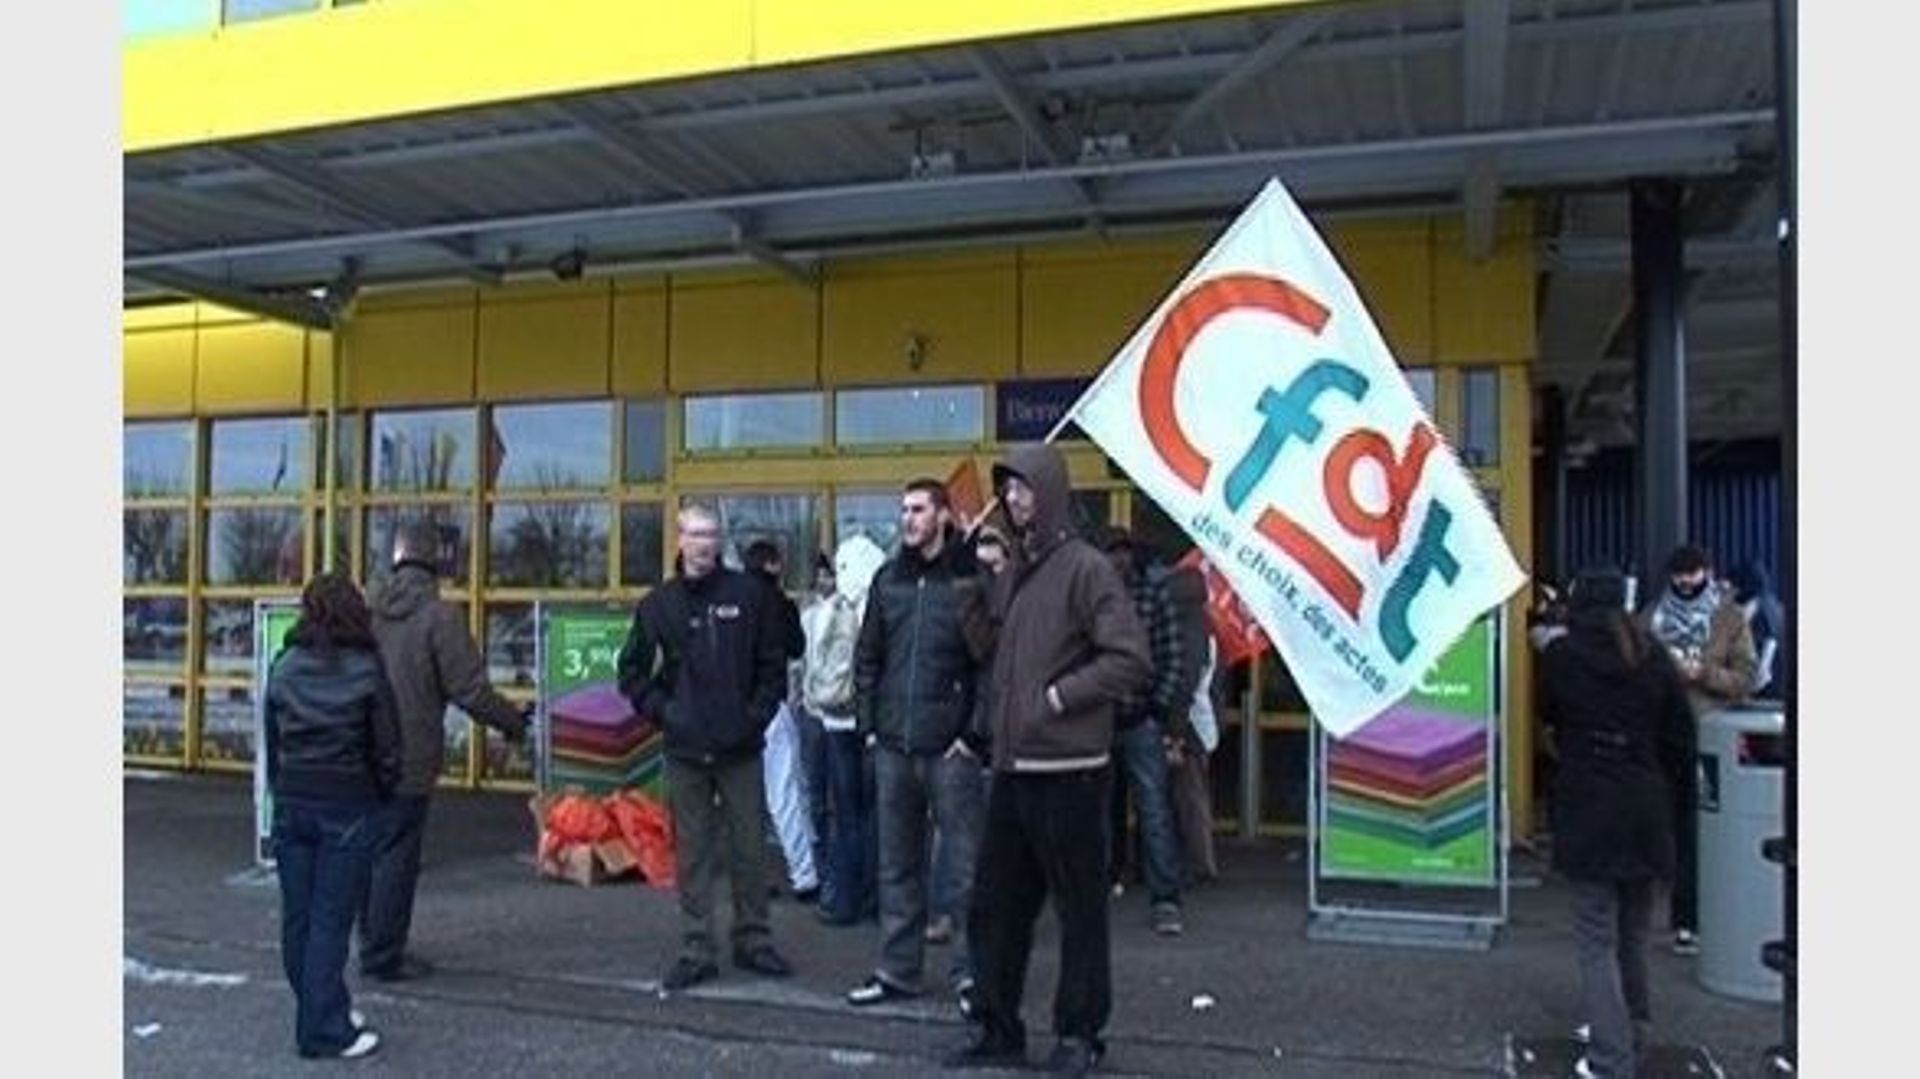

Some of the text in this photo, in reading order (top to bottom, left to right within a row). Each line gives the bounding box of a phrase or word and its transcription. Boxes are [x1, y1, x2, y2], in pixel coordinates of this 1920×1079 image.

[1192, 512, 1234, 549] des
[1302, 604, 1336, 640] des
[1332, 637, 1388, 693] actes
